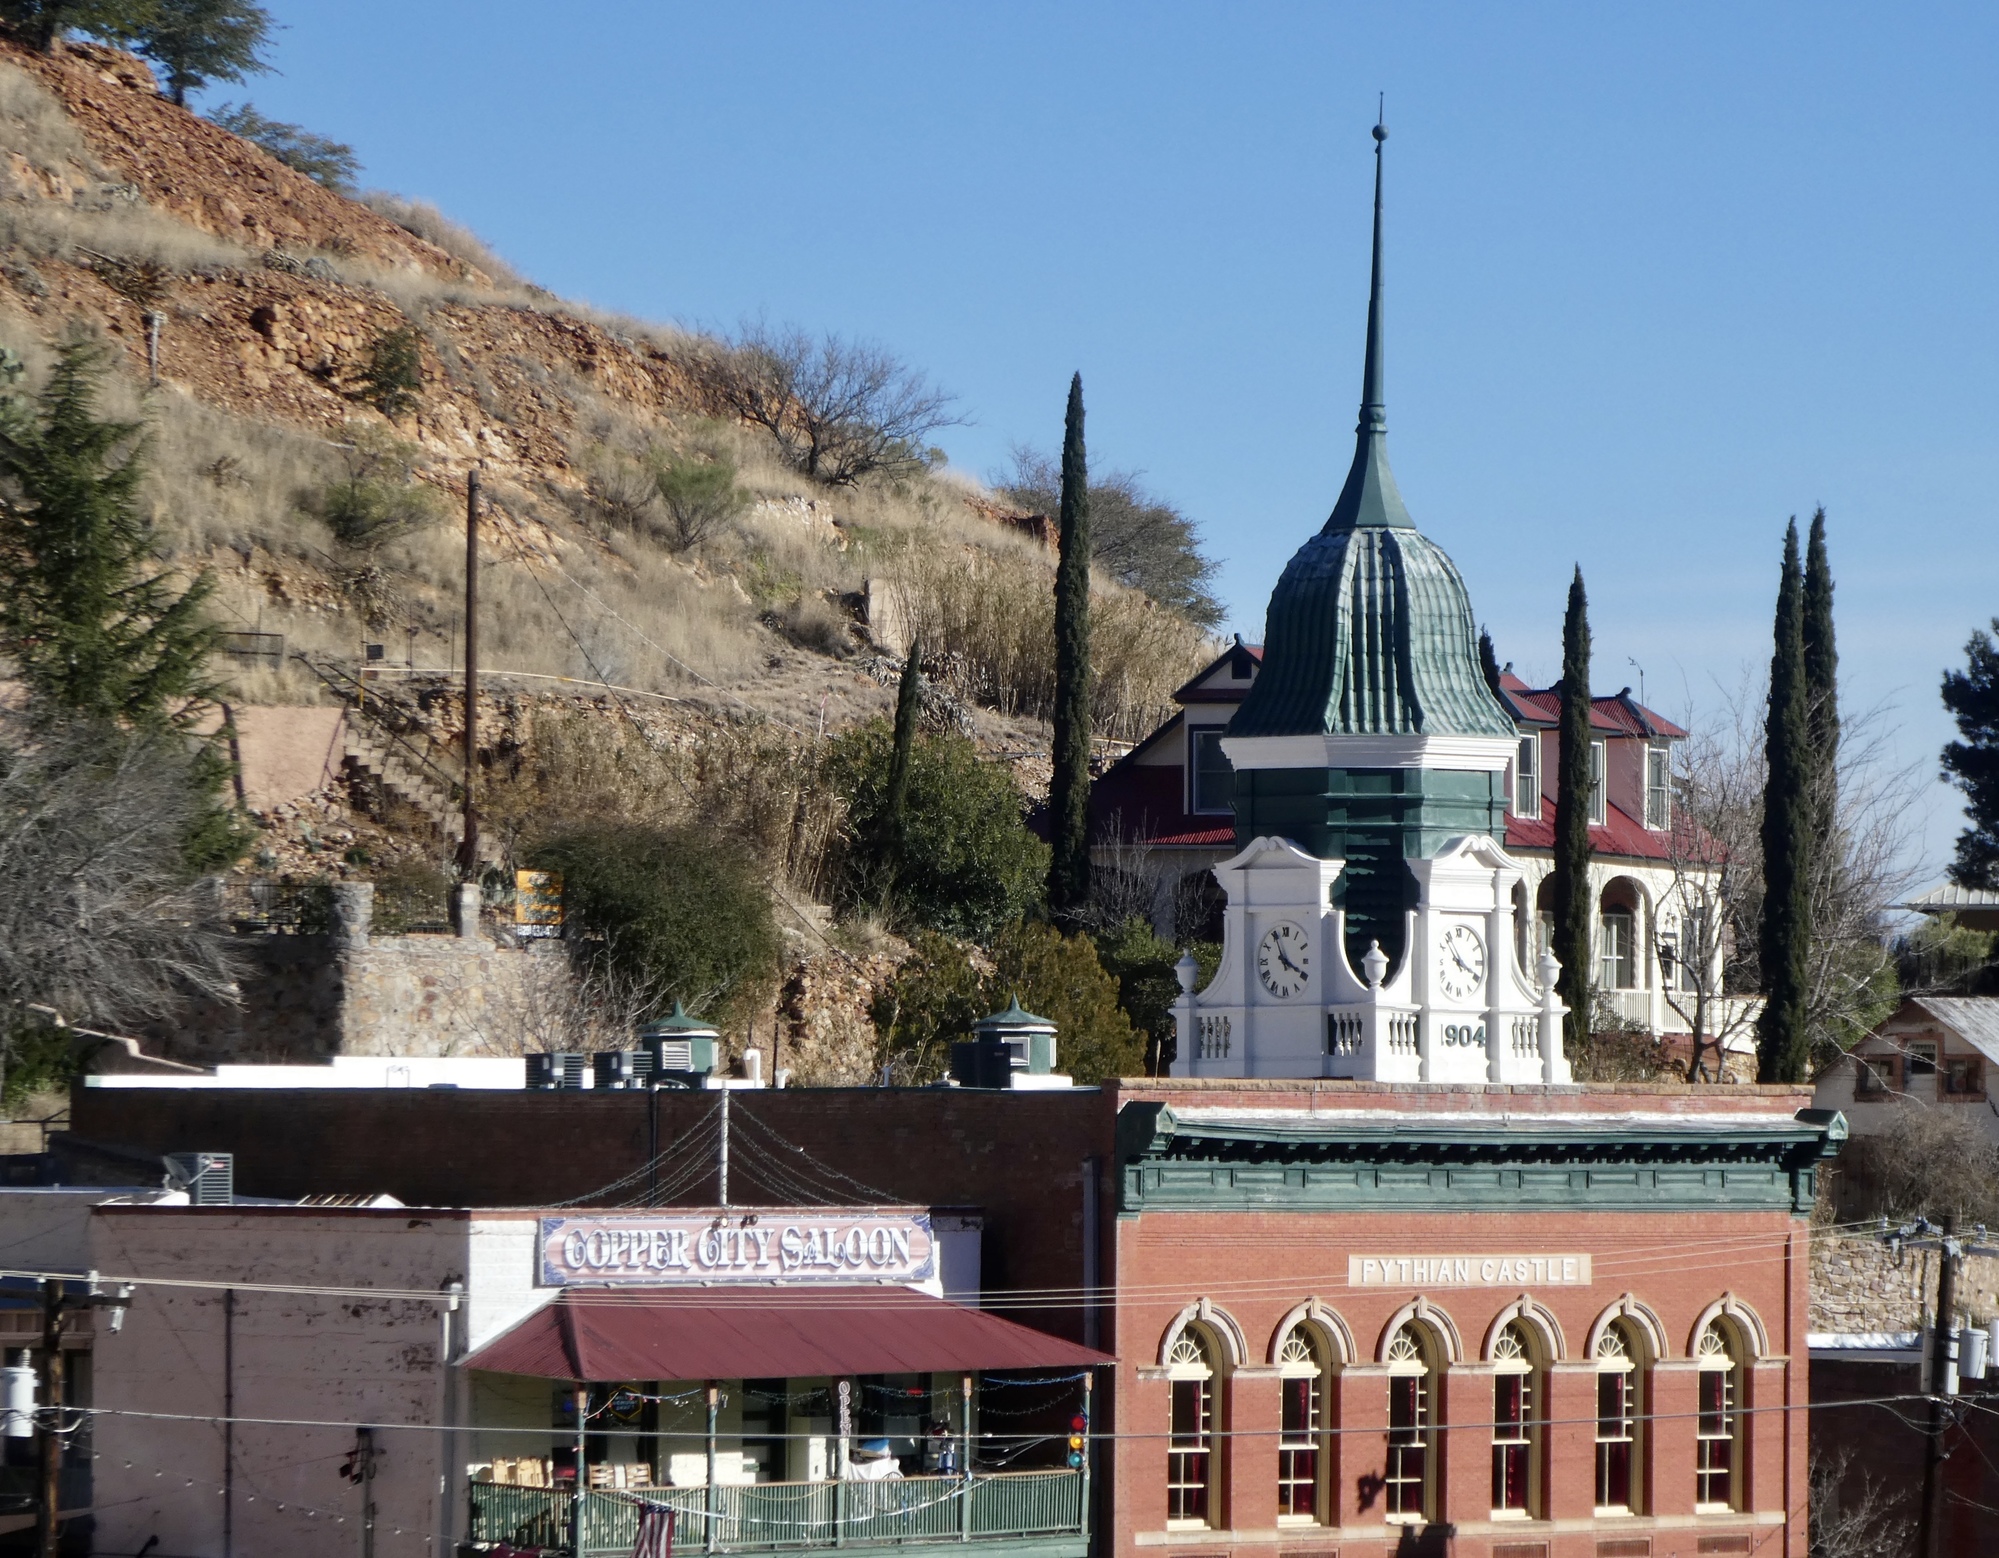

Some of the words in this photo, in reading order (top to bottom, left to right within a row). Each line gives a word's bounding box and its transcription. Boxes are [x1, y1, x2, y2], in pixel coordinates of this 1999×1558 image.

[1440, 1023, 1486, 1049] 1904
[564, 1228, 692, 1269] COPPER
[698, 1226, 775, 1268] CITY
[781, 1225, 912, 1270] SALOON
[1361, 1258, 1470, 1283] PYTHIAN
[1480, 1257, 1577, 1282] CASTLE
[838, 1381, 852, 1438] OPEN
